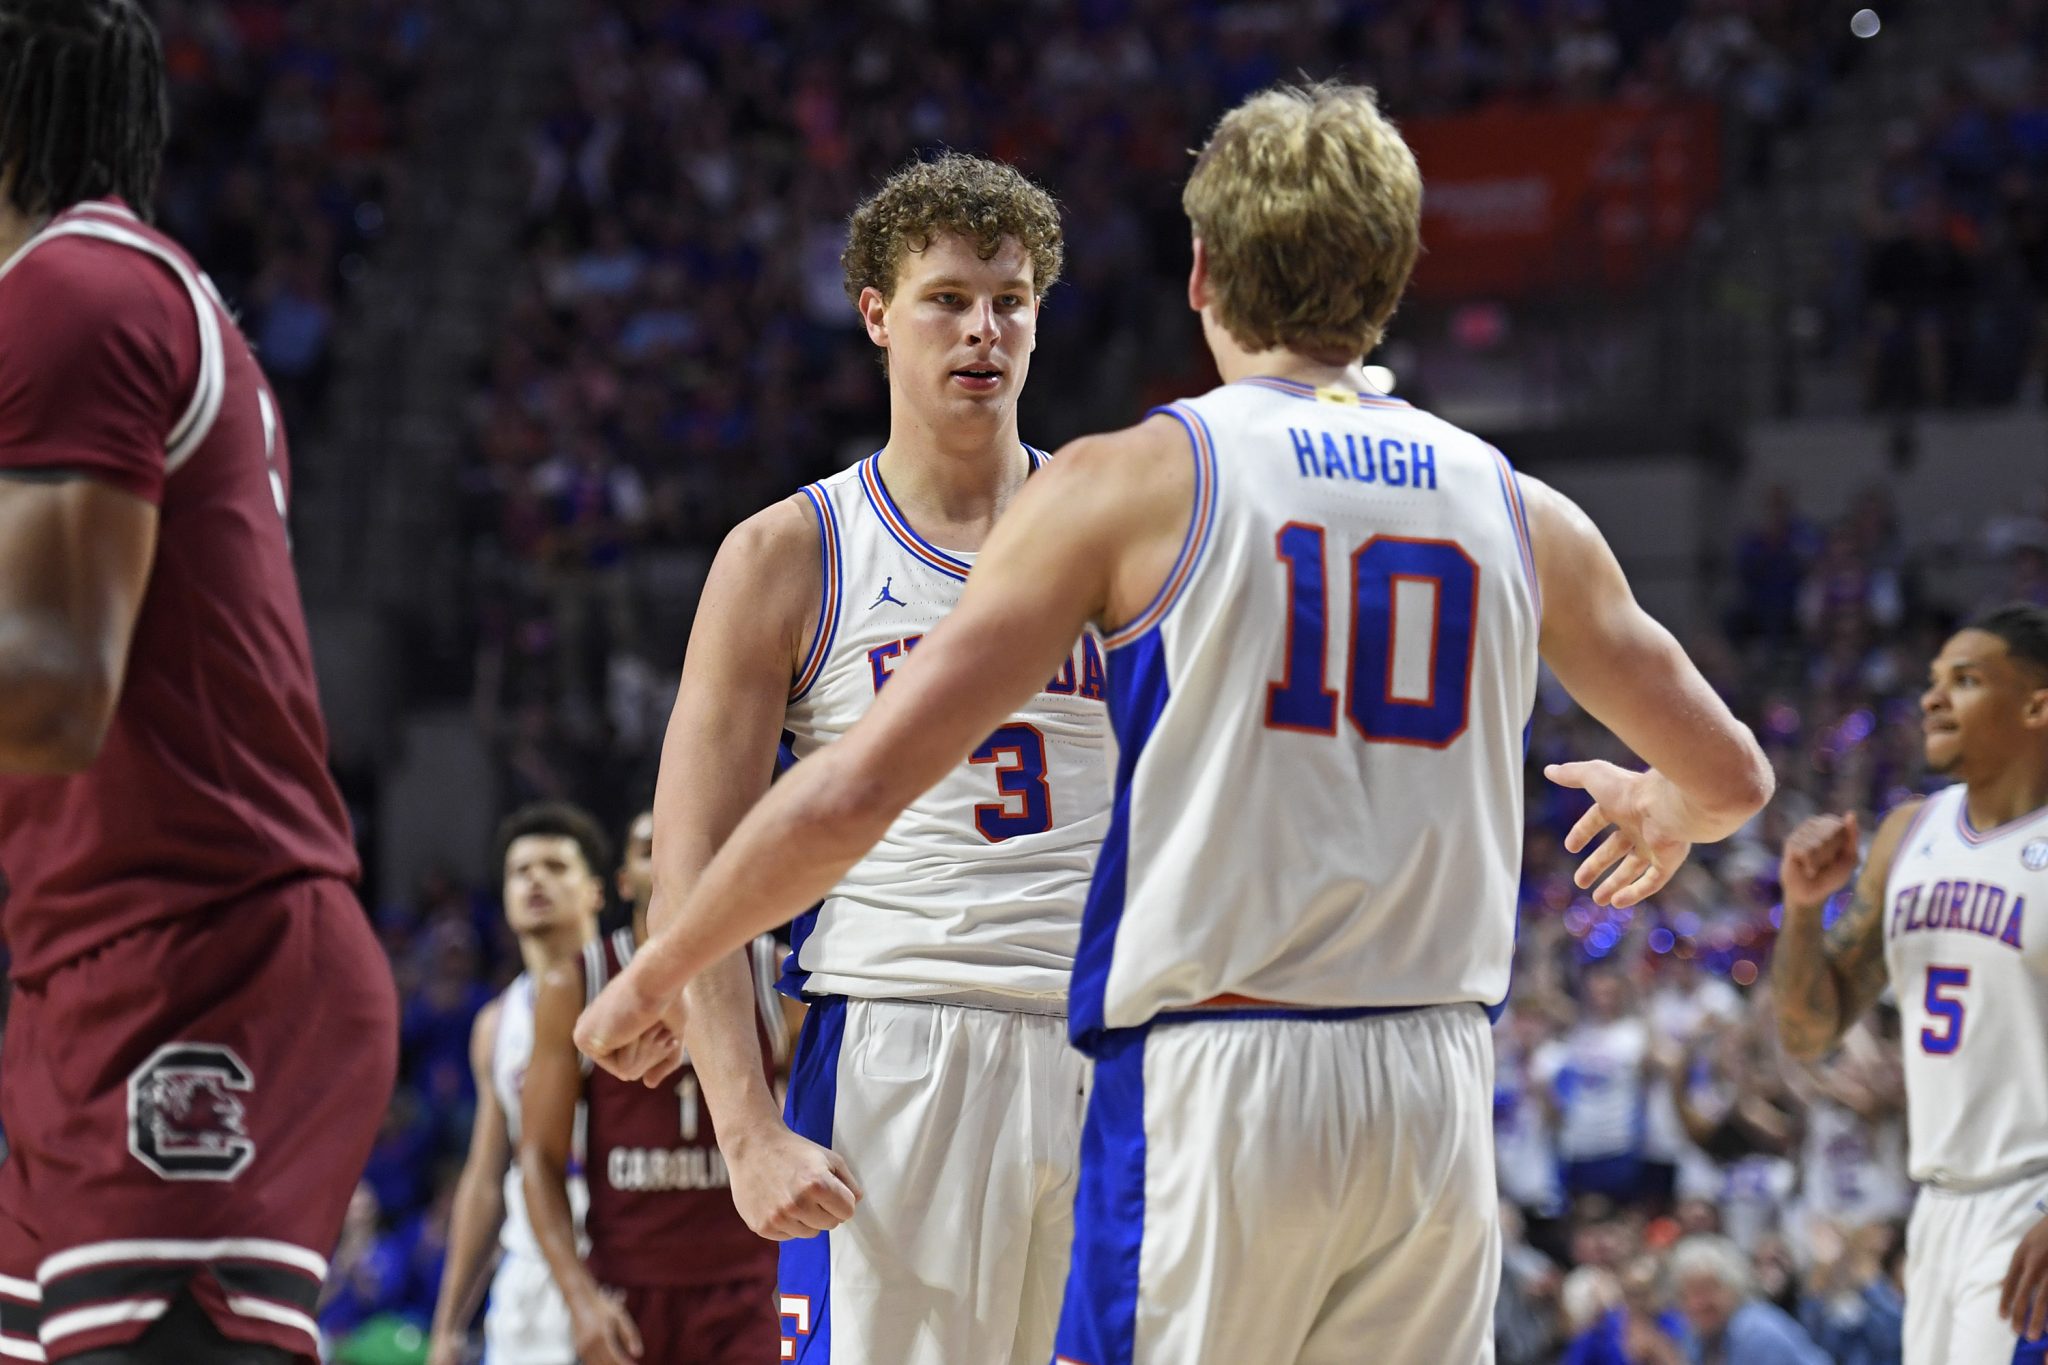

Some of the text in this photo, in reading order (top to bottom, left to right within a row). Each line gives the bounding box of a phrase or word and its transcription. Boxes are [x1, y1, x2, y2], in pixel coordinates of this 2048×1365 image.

[1288, 427, 1437, 490] HAUGH
[1264, 520, 1480, 750] 10
[968, 721, 1053, 843] 3
[1891, 880, 2023, 950] FLORIDA
[1920, 965, 1970, 1056] 5
[608, 1145, 730, 1191] CAROLI
